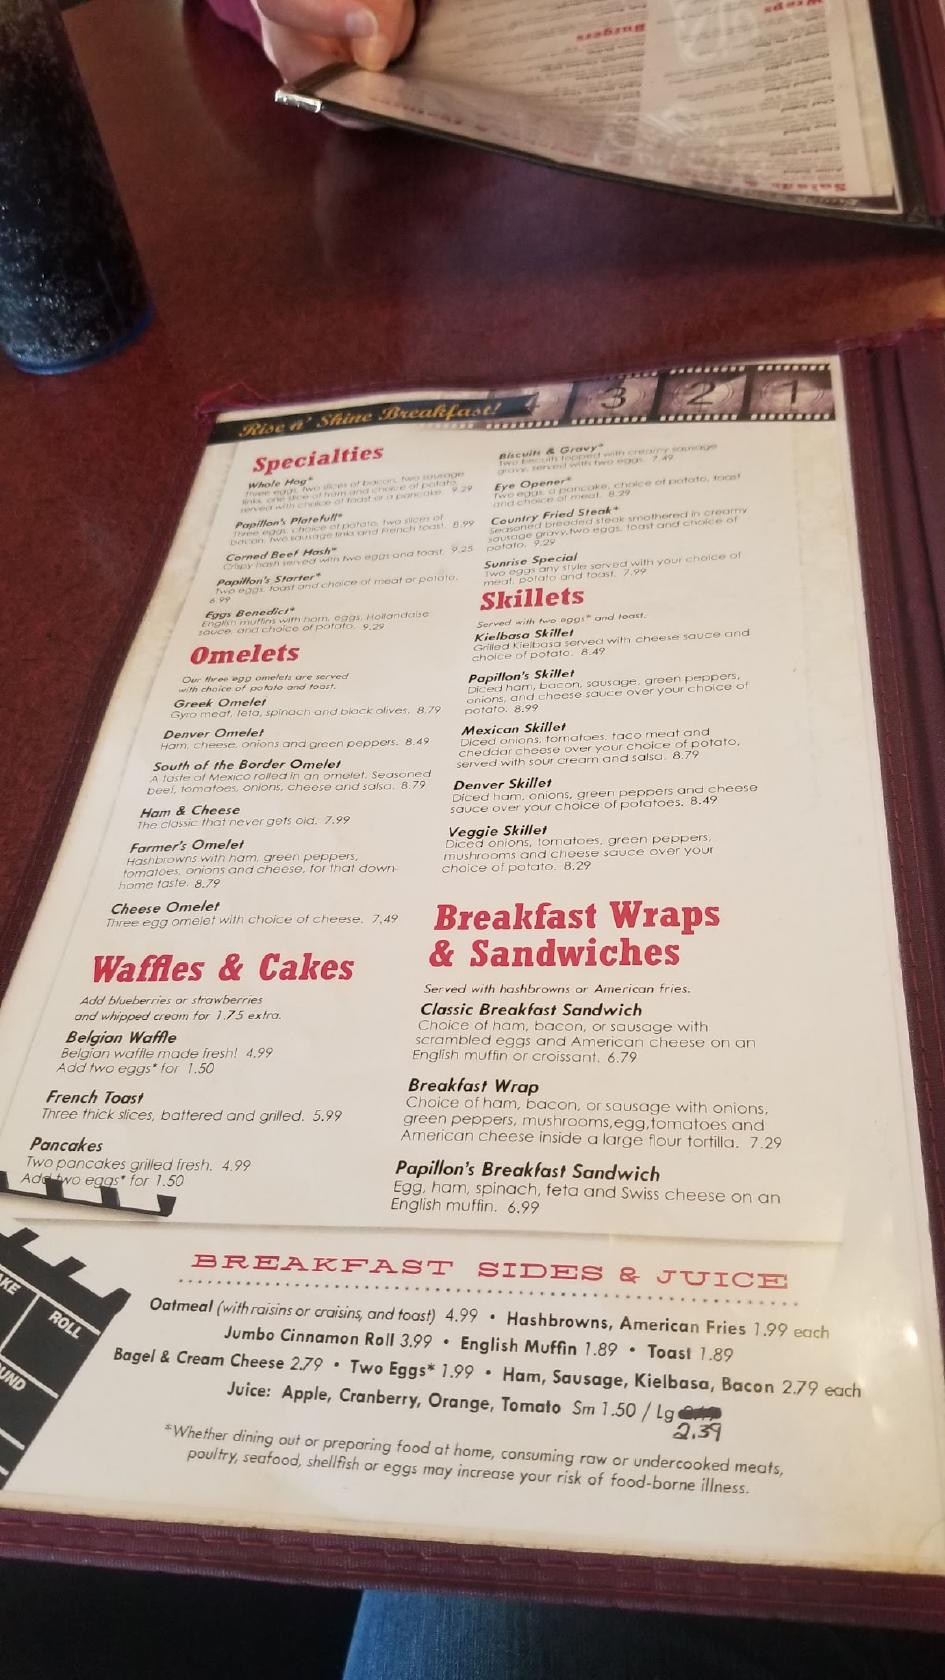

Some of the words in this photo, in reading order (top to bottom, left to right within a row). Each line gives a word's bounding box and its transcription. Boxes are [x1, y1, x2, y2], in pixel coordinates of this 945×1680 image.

[239, 419, 287, 437] Rise
[316, 413, 372, 429] Shine
[379, 403, 503, 421] Breakfast!
[253, 446, 384, 475] Specialties
[499, 449, 541, 460] Biscuits
[546, 447, 554, 456] &
[248, 479, 282, 489] Whole
[495, 481, 516, 492] Eye
[235, 518, 286, 530] Papillon's
[491, 514, 539, 525] Country
[543, 509, 574, 519] Fried
[226, 552, 268, 562] Corned
[272, 550, 299, 559] Beef
[484, 558, 527, 569] Sunrise
[532, 553, 578, 566] Special
[217, 576, 272, 587] Papillon's
[480, 587, 584, 611] Skillets
[205, 610, 232, 620] Eggs
[474, 630, 530, 642] Kielbasa
[535, 628, 574, 638] Skillet
[190, 644, 300, 665] Omelets
[468, 671, 529, 684] Papillon's
[534, 669, 575, 679] Skillet
[173, 698, 213, 709] Greek
[218, 698, 266, 707] Omelet
[163, 729, 210, 740] Denver
[214, 728, 264, 738] Omelet
[461, 725, 520, 736] Mexican
[524, 722, 566, 733] Skillet
[153, 760, 190, 772] South
[194, 760, 210, 770] of
[213, 759, 234, 770] the
[239, 758, 286, 770] Border
[290, 758, 341, 769] Omelet
[453, 780, 505, 791] Denver
[509, 777, 552, 789] Skillet
[140, 808, 171, 818] Ham
[176, 806, 186, 816] &
[191, 804, 240, 815] Cheese
[449, 825, 498, 840] Veggie
[503, 824, 547, 836] Skillet
[129, 840, 187, 854] Farmer's
[192, 839, 244, 850] Omelet
[111, 903, 161, 915] Cheese
[166, 900, 220, 913] Omelet
[434, 902, 597, 930] Breakfast
[609, 900, 720, 935] Wraps
[429, 939, 454, 967] &
[470, 937, 680, 967] Sandwiches
[93, 954, 205, 983] Waffles
[218, 953, 243, 981] &
[259, 952, 354, 981] Cakes
[421, 1002, 473, 1015] Classic
[479, 1002, 557, 1016] Breakfast
[562, 1003, 642, 1016] Sandwich
[65, 1030, 123, 1047] Belgian
[129, 1030, 177, 1044] Waffle
[61, 1047, 110, 1061] Belgian
[114, 1048, 154, 1059] waffle
[157, 1048, 199, 1059] made
[202, 1047, 238, 1059] fresh!
[246, 1047, 273, 1059] 4.99
[408, 1077, 487, 1092] Breakfast
[495, 1079, 539, 1096] Wrap
[46, 1089, 98, 1104] French
[104, 1091, 144, 1104] Toast
[29, 1136, 103, 1152] Pancakes
[395, 1159, 475, 1179] Papillon's
[481, 1161, 566, 1178] Breakfast
[572, 1163, 660, 1182] Sandwich
[191, 1254, 453, 1275] BREAKFAST
[478, 1262, 603, 1281] SIDES
[619, 1267, 640, 1284] &
[656, 1270, 788, 1289] JUICE
[48, 1310, 81, 1339] ROLL
[150, 1297, 214, 1312] Oatmeal
[217, 1300, 249, 1317] (with
[250, 1302, 293, 1316] raisins
[295, 1308, 311, 1317] or
[314, 1305, 363, 1322] craisins,
[367, 1307, 395, 1320] and
[398, 1308, 435, 1325] toast)
[445, 1307, 478, 1323] 4.99
[507, 1311, 613, 1331] Hashbrowns,
[619, 1315, 699, 1333] American
[706, 1320, 746, 1335] Fries
[754, 1322, 788, 1337] 1.99
[793, 1325, 830, 1339] each
[224, 1325, 274, 1341] Jumbo
[280, 1328, 359, 1345] Cinnamon
[365, 1332, 395, 1347] Roll
[400, 1333, 432, 1348] 3.99
[461, 1336, 518, 1355] English
[524, 1339, 577, 1355] Muffin
[586, 1341, 618, 1357] 1.89
[647, 1344, 691, 1360] Toast
[701, 1347, 734, 1362] 1.89
[114, 1347, 156, 1365] Bagel
[160, 1350, 170, 1363] &
[177, 1350, 224, 1366] Cream
[230, 1353, 284, 1370] Cheese
[290, 1356, 323, 1372] 2.79
[350, 1359, 383, 1375] Two
[442, 1363, 474, 1379] 1.99
[503, 1366, 546, 1385] Ham,
[553, 1369, 628, 1390] Sausage,
[635, 1373, 714, 1393] Kielbasa,
[722, 1376, 774, 1393] Bacon
[782, 1380, 818, 1396] 2.79
[824, 1382, 861, 1398] each
[227, 1381, 271, 1397] Juice:
[281, 1385, 332, 1404] Apple,
[339, 1387, 421, 1409] Cranberry,
[428, 1392, 494, 1413] Orange,
[501, 1396, 561, 1414] Tomato
[572, 1400, 595, 1415] Sm
[603, 1401, 636, 1418] 1.50
[641, 1401, 652, 1423] /
[656, 1404, 675, 1423] Lg
[672, 1422, 722, 1442] 2.39
[233, 1429, 274, 1448] dining
[278, 1434, 301, 1446] out
[304, 1438, 320, 1447] or
[322, 1438, 392, 1456] preparing
[397, 1439, 431, 1454] food
[434, 1444, 450, 1455] at
[453, 1443, 495, 1460] home,
[501, 1448, 574, 1467] consuming
[579, 1455, 607, 1465] raw
[612, 1457, 629, 1466] or
[634, 1454, 730, 1472] undercooked
[735, 1461, 783, 1477] meats,
